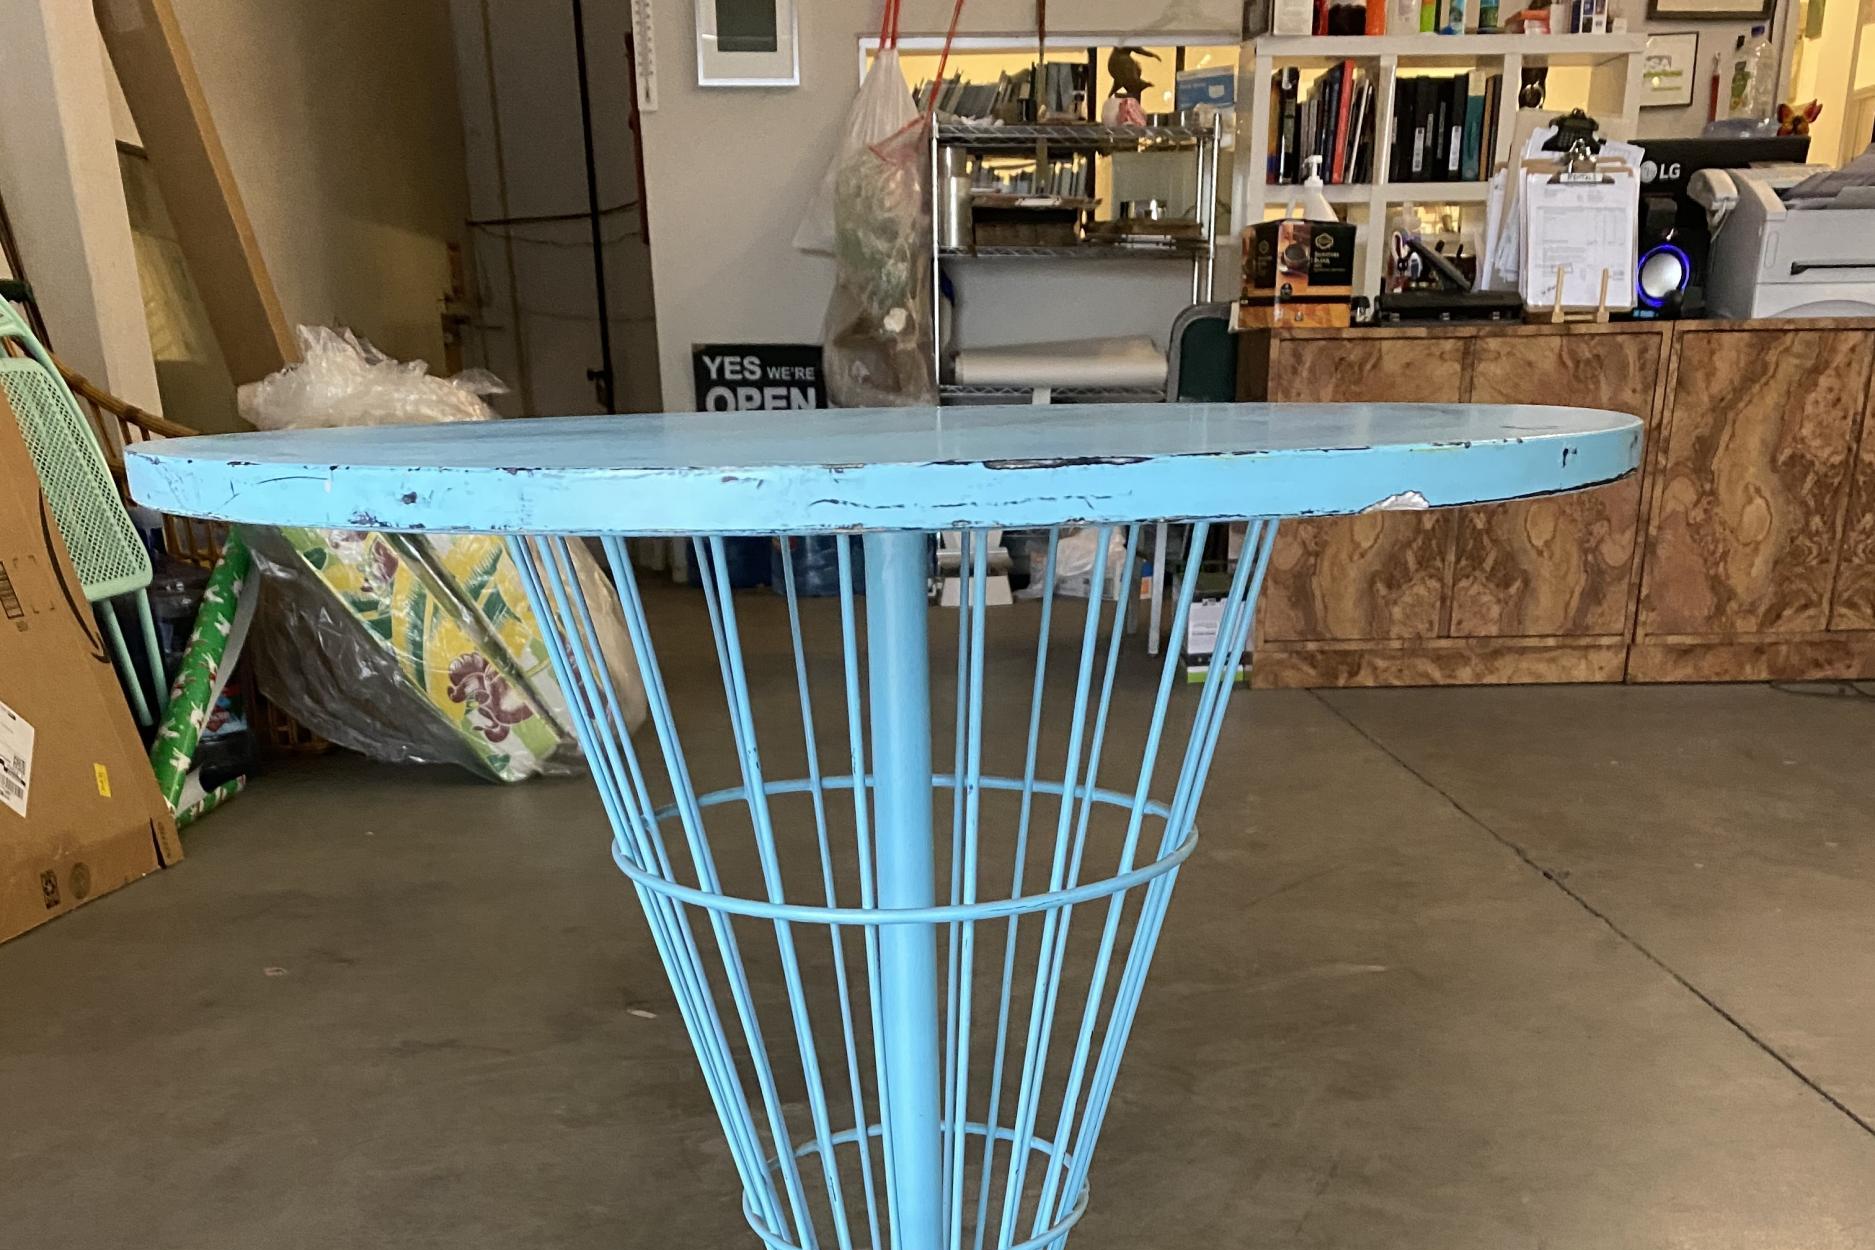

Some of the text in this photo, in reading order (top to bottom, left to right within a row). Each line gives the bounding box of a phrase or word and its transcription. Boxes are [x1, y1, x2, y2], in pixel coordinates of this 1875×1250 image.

[1659, 163, 1681, 179] LG
[702, 355, 816, 380] YES WE'RE
[705, 386, 817, 411] OPEN
